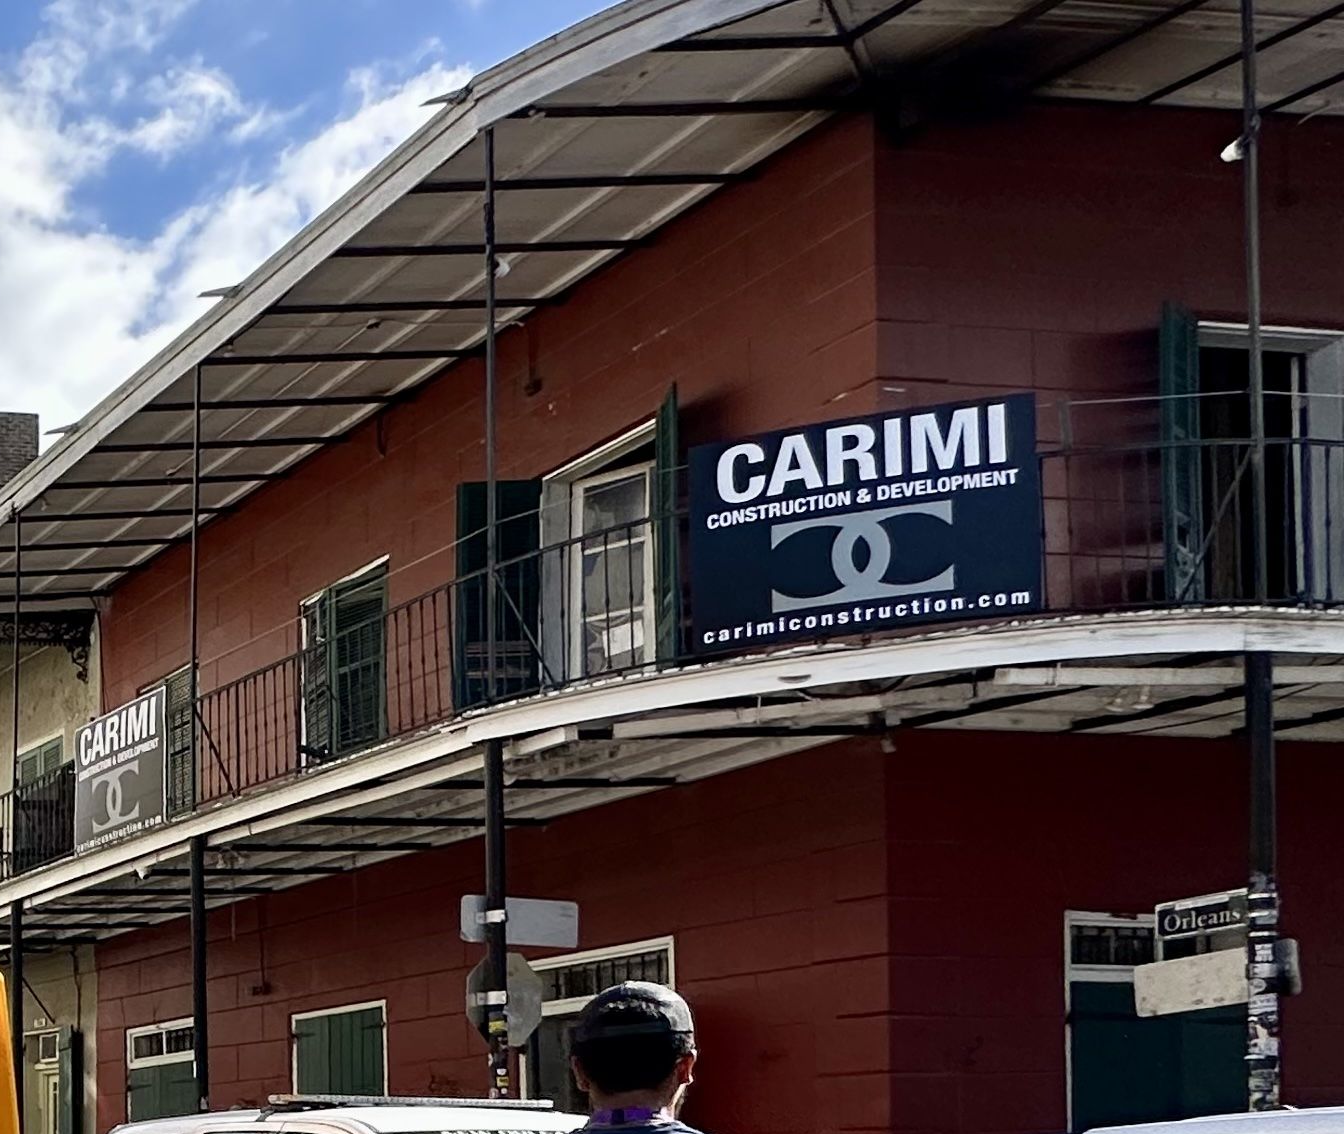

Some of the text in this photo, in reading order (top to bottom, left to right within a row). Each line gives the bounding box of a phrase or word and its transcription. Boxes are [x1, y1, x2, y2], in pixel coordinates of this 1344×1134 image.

[716, 403, 1007, 503] CARIMI
[706, 469, 1020, 529] CONSTRUCTION & DEVELOPMENT
[703, 591, 1031, 644] carimiconstruction.com
[80, 696, 157, 766] CARIMI
[1164, 910, 1241, 931] Orleans
